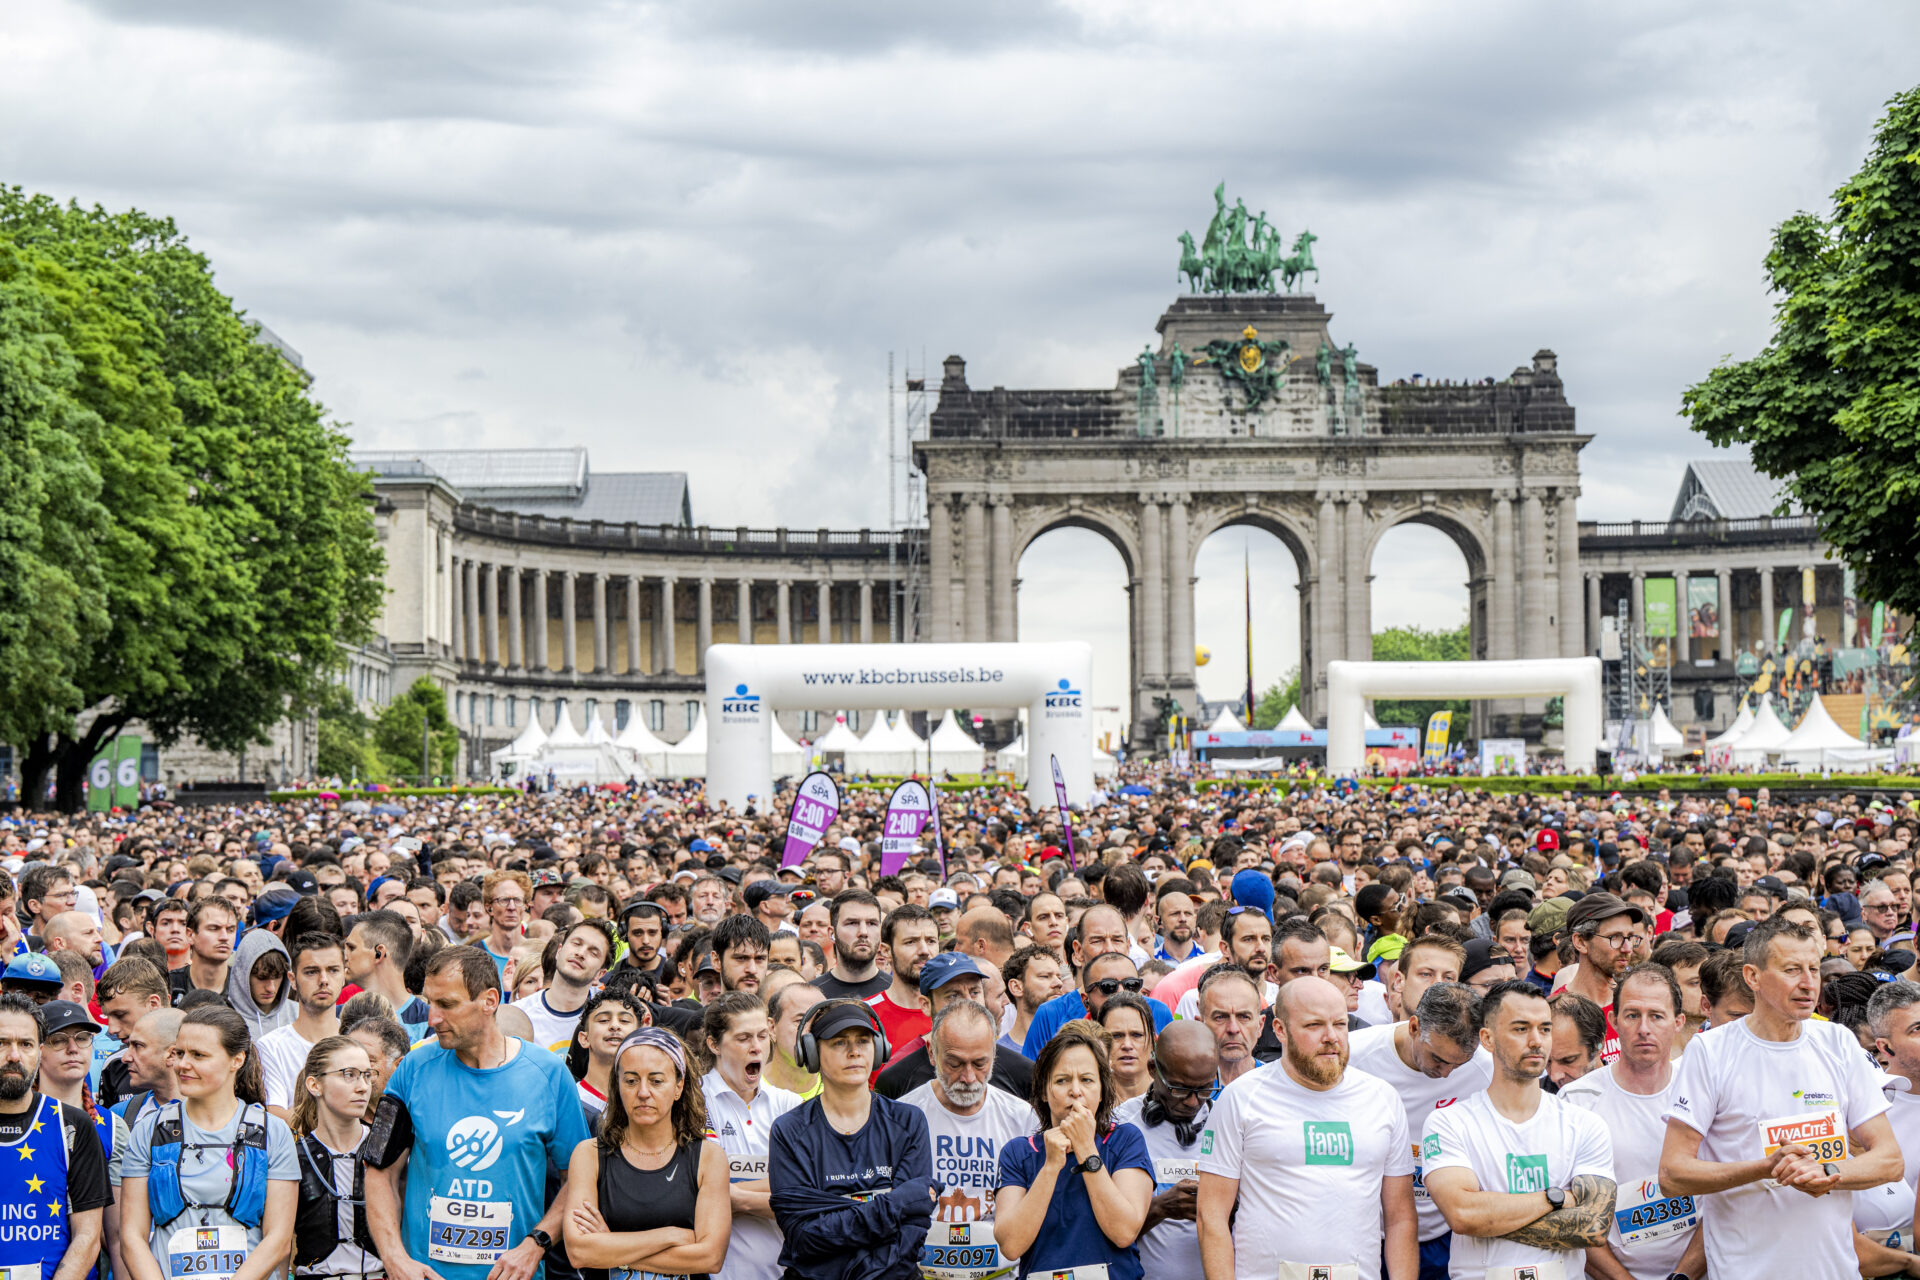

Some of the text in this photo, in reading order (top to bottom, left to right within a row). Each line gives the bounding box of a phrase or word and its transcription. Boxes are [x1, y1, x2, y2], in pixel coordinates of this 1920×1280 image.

[803, 668, 1003, 685] www.kbcbrussels.be
[723, 703, 759, 712] KBC
[1045, 698, 1082, 707] KBC
[91, 758, 111, 789] 6
[117, 757, 138, 787] 6
[811, 784, 830, 800] SPA
[901, 795, 919, 805] SPA
[795, 798, 825, 828] 2:00
[888, 812, 918, 835] 2:00
[0, 1125, 23, 1134] oma
[936, 1135, 995, 1159] RUN
[1308, 1125, 1350, 1161] facq
[1808, 1139, 1844, 1161] 389
[729, 1161, 769, 1173] GAR
[936, 1158, 995, 1173] COURIR
[936, 1172, 995, 1188] LOPEN
[1510, 1157, 1546, 1193] facq
[447, 1178, 493, 1198] ATD
[985, 1190, 994, 1202] B
[2, 1203, 37, 1220] ING
[447, 1202, 494, 1218] GBL
[985, 1204, 994, 1215] X
[1631, 1195, 1693, 1227] 42383
[0, 1225, 61, 1241] UROPE
[1672, 1220, 1687, 1231] 2024
[441, 1226, 506, 1248] 47295
[182, 1253, 244, 1273] 26119
[933, 1248, 996, 1266] 26097
[969, 1270, 984, 1279] 2024
